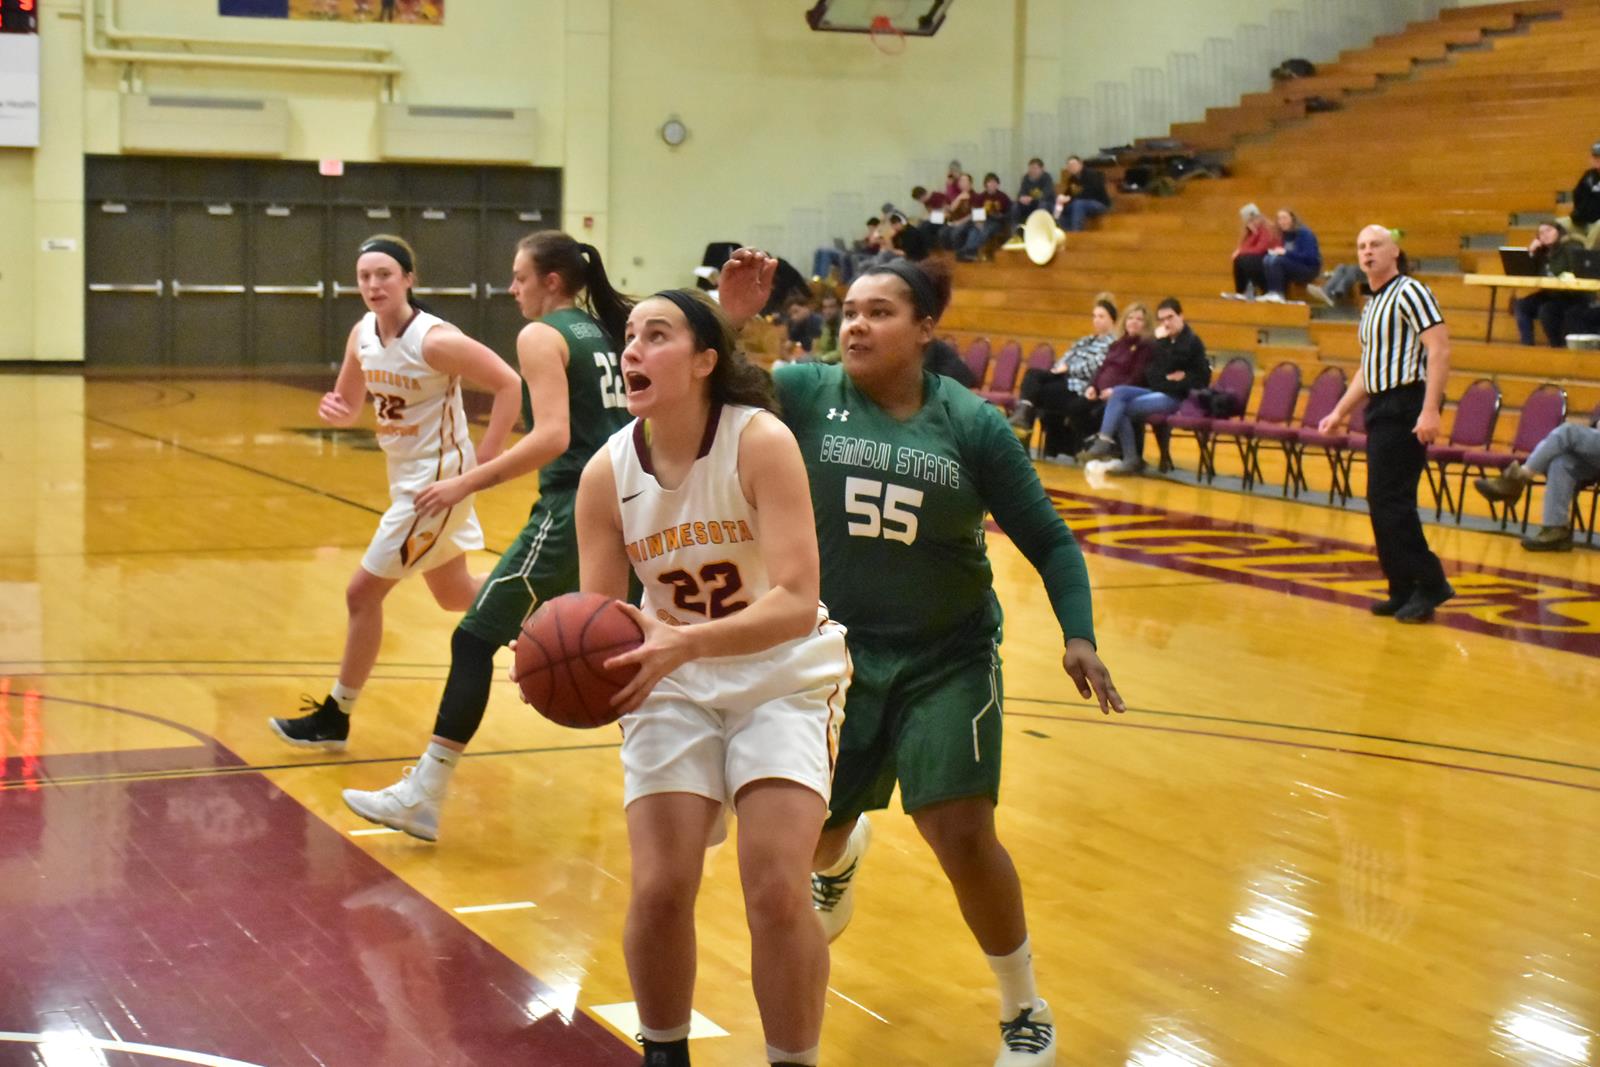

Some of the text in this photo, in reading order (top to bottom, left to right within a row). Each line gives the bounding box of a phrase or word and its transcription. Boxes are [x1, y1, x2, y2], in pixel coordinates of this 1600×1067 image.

[820, 434, 960, 490] BEMIDJI STATE
[844, 475, 925, 546] 55
[625, 519, 754, 563] MINNESOTA
[657, 561, 749, 619] 22
